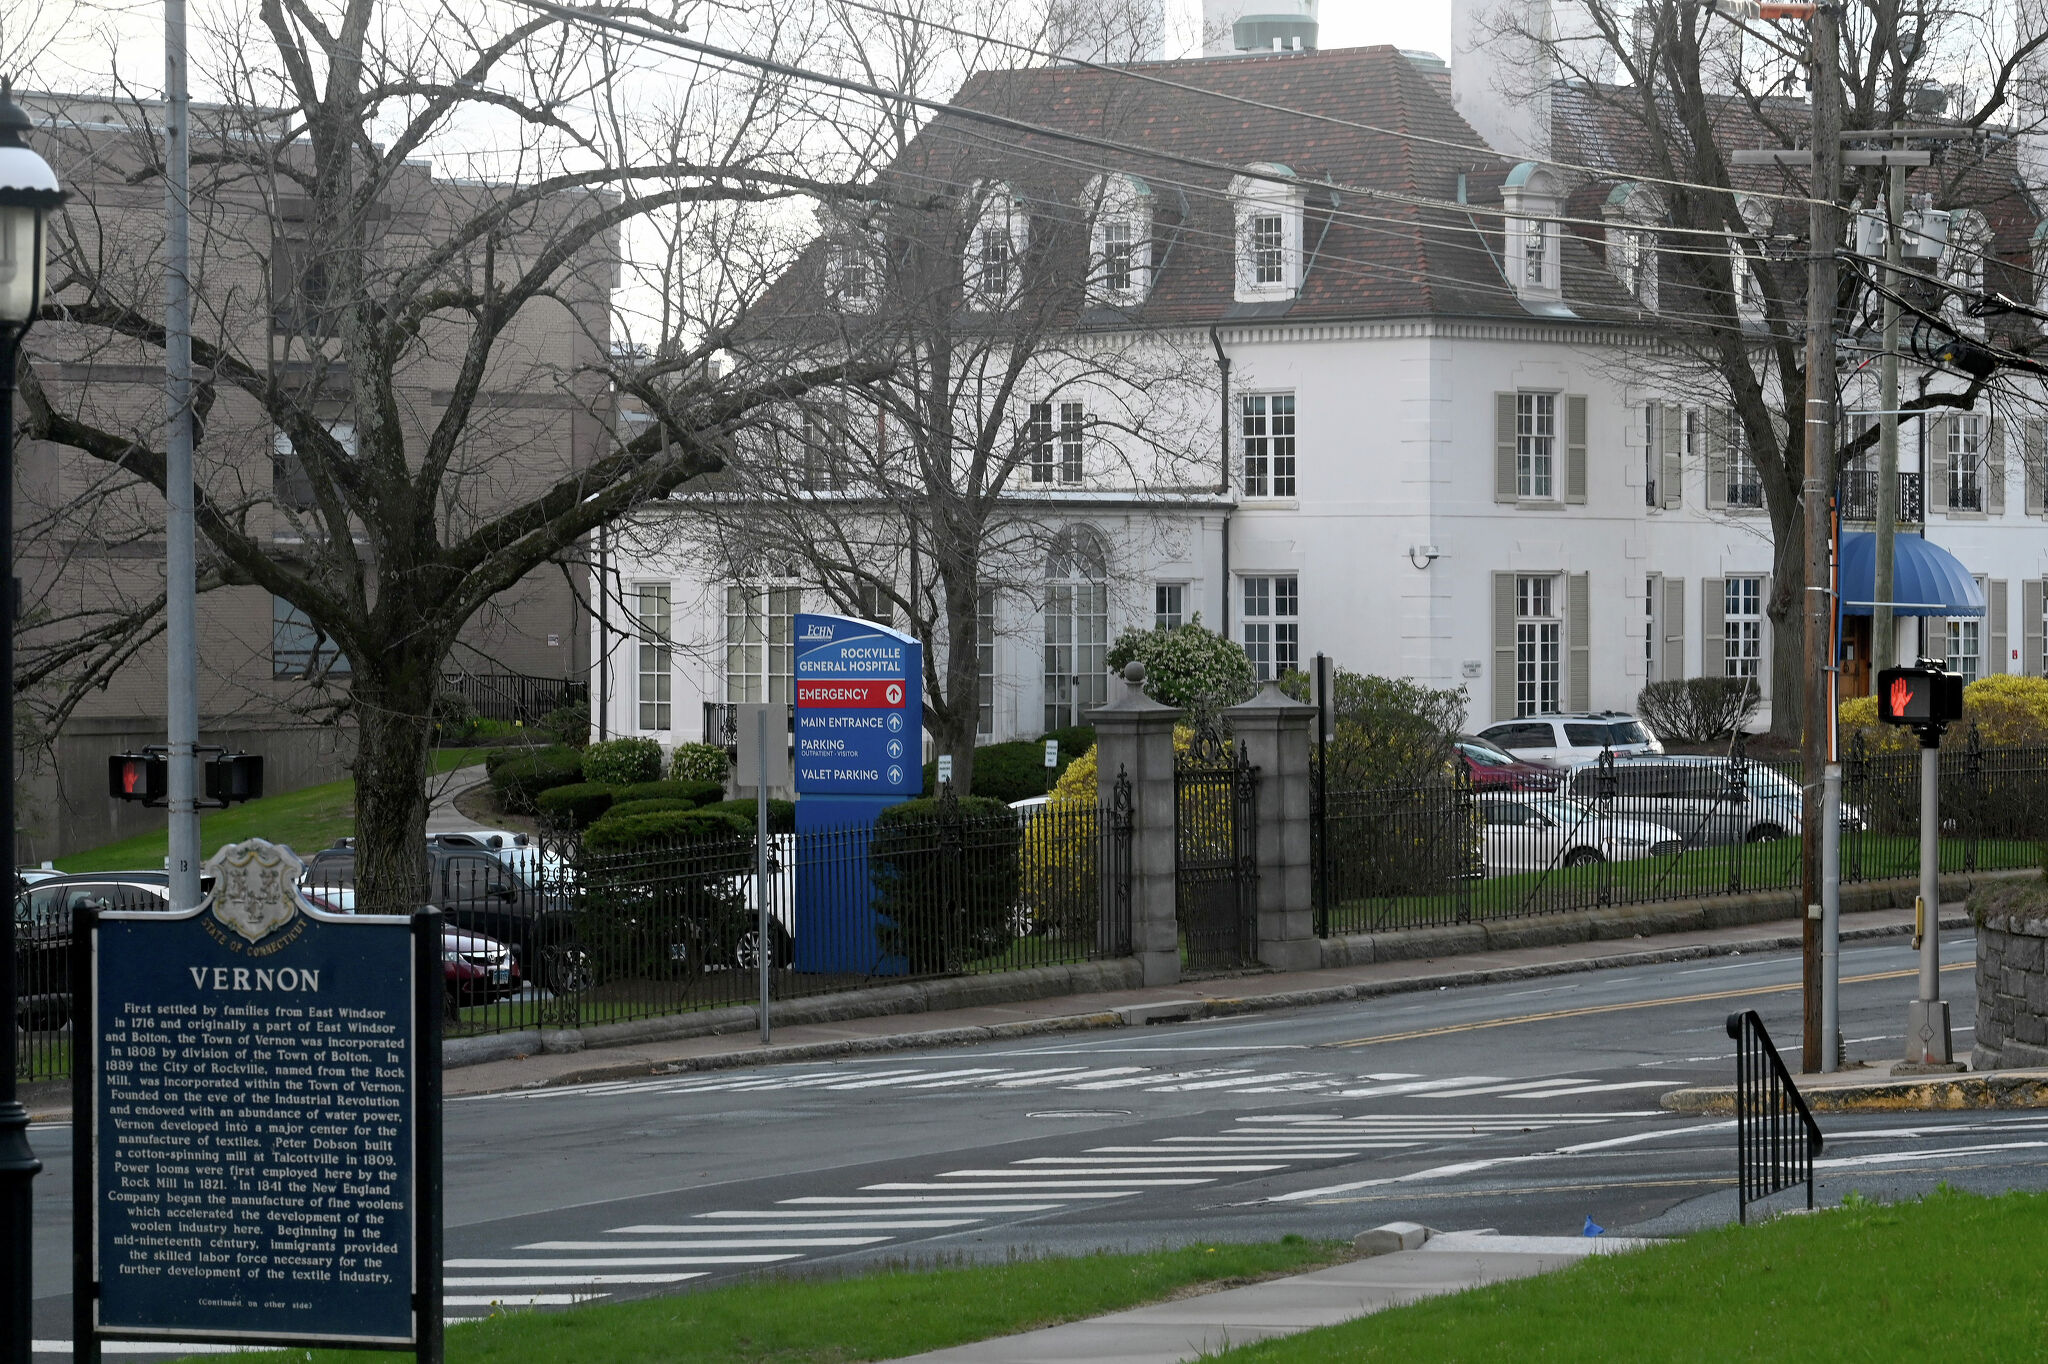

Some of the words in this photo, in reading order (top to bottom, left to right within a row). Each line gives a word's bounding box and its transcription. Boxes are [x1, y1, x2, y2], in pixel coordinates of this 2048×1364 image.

[807, 624, 835, 637] ECHN
[841, 648, 901, 659] ROCKVILLE
[799, 661, 847, 672] GENERAL
[849, 661, 901, 672] HOSPITAL
[799, 688, 869, 700] EMERGENCY
[801, 717, 826, 728] MAIN
[828, 717, 884, 728] ENTRANCE
[801, 739, 845, 750] PARKING
[801, 769, 831, 780] VALET
[834, 769, 879, 781] PARKING
[201, 917, 229, 945] STATE
[230, 940, 243, 953] OF
[247, 918, 308, 957] CONNECTICUT
[189, 967, 321, 993] VERNON
[125, 1001, 151, 1014] First
[158, 1002, 197, 1015] settled
[203, 1003, 217, 1017] by
[224, 1003, 269, 1016] families
[276, 1004, 302, 1017] from
[309, 1005, 333, 1017] East
[339, 1006, 386, 1019] Windsor
[115, 1015, 125, 1028] in
[132, 1016, 155, 1028] 1716
[161, 1017, 181, 1029] and
[188, 1017, 246, 1033] originally
[253, 1021, 259, 1031] a
[266, 1020, 291, 1033] part
[298, 1020, 311, 1032] of
[317, 1020, 341, 1032] East
[348, 1021, 395, 1034] Windsor
[105, 1030, 126, 1042] and
[178, 1031, 196, 1043] the
[202, 1032, 232, 1044] Town
[238, 1033, 250, 1045] of
[255, 1033, 295, 1046] Vernon
[301, 1036, 322, 1046] was
[328, 1034, 404, 1050] incorporated
[111, 1044, 121, 1056] in
[128, 1045, 156, 1057] 1808
[162, 1045, 176, 1060] by
[182, 1046, 228, 1059] division
[235, 1047, 247, 1059] of
[253, 1048, 271, 1060] the
[277, 1048, 308, 1061] Town
[314, 1049, 326, 1061] of
[387, 1051, 399, 1063] In
[106, 1058, 133, 1071] 1889
[140, 1059, 157, 1072] the
[164, 1060, 188, 1075] City
[194, 1061, 206, 1073] of
[275, 1063, 312, 1075] named
[318, 1064, 345, 1076] from
[351, 1065, 369, 1077] the
[376, 1065, 405, 1078] Rock
[112, 1087, 159, 1101] Founded
[164, 1091, 178, 1101] on
[184, 1089, 202, 1102] the
[208, 1092, 228, 1102] eve
[234, 1091, 246, 1103] of
[252, 1091, 270, 1103] the
[275, 1092, 331, 1105] Industrial
[337, 1093, 399, 1107] Revolution
[110, 1102, 130, 1115] and
[135, 1103, 184, 1116] endowed
[190, 1104, 214, 1117] with
[220, 1108, 233, 1117] an
[239, 1106, 301, 1119] abundance
[306, 1107, 319, 1120] of
[325, 1109, 357, 1121] water
[115, 1117, 154, 1130] Vernon
[161, 1118, 219, 1133] developed
[225, 1120, 248, 1132] into
[255, 1123, 262, 1133] a
[268, 1123, 304, 1136] major
[310, 1124, 348, 1135] center
[354, 1123, 371, 1136] for
[378, 1124, 397, 1136] the
[119, 1132, 191, 1145] manufacture
[198, 1134, 209, 1146] of
[216, 1135, 261, 1147] textiles.
[275, 1136, 306, 1148] Peter
[314, 1137, 357, 1150] Dobson
[365, 1138, 392, 1151] built
[115, 1148, 122, 1158] a
[128, 1147, 219, 1163] cotton-spinning
[226, 1149, 246, 1161] mill
[254, 1151, 264, 1162] at
[272, 1150, 339, 1164] Talcottville
[346, 1152, 357, 1164] in
[364, 1153, 396, 1166] 1809.
[115, 1160, 150, 1173] Power
[156, 1161, 189, 1174] looms
[196, 1165, 223, 1175] were
[230, 1163, 255, 1176] first
[263, 1165, 317, 1180] employed
[325, 1166, 352, 1179] here
[359, 1167, 372, 1182] by
[378, 1168, 397, 1180] the
[121, 1175, 150, 1187] Rock
[157, 1176, 177, 1188] Mill
[184, 1177, 194, 1189] in
[200, 1177, 227, 1190] 1821.
[240, 1178, 250, 1190] In
[258, 1179, 281, 1191] 1841
[288, 1180, 306, 1192] the
[313, 1180, 336, 1193] New
[344, 1181, 390, 1196] England
[108, 1189, 160, 1204] Company
[167, 1190, 201, 1205] began
[208, 1192, 226, 1204] the
[232, 1193, 304, 1207] manufacture
[310, 1195, 323, 1207] of
[328, 1195, 350, 1208] fine
[357, 1197, 404, 1210] woolens
[127, 1204, 160, 1217] which
[167, 1206, 233, 1219] accelerated
[241, 1208, 260, 1220] the
[267, 1208, 341, 1224] development
[347, 1211, 360, 1223] of
[366, 1212, 384, 1224] the
[131, 1219, 171, 1231] woolen
[179, 1220, 227, 1236] industry
[234, 1222, 263, 1234] here.
[278, 1223, 337, 1239] Beginning
[344, 1225, 355, 1237] in
[362, 1226, 380, 1238] the
[114, 1233, 201, 1247] mid-nineteenth
[271, 1237, 335, 1253] immigrants
[344, 1241, 398, 1254] provided
[129, 1247, 147, 1260] the
[154, 1248, 191, 1261] skilled
[199, 1250, 230, 1262] labor
[237, 1251, 267, 1264] force
[274, 1255, 332, 1268] necessary
[339, 1254, 356, 1267] for
[364, 1255, 382, 1268] the
[120, 1261, 161, 1275] further
[167, 1263, 240, 1279] development
[248, 1266, 260, 1278] of
[267, 1267, 285, 1279] the
[292, 1268, 331, 1281] textile
